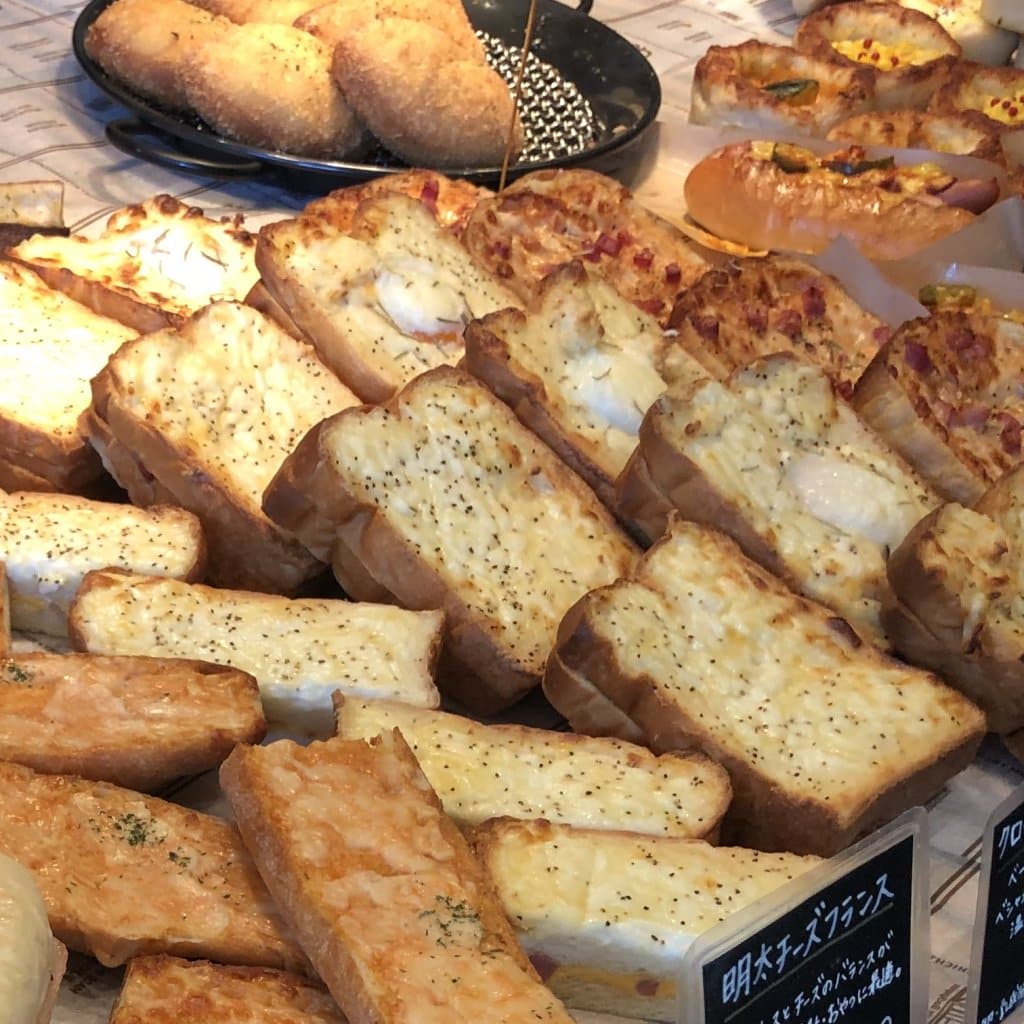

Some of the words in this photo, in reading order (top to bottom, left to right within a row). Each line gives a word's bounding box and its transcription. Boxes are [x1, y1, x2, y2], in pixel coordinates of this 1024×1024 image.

[721, 873, 895, 1005] 明太チーズフランス
